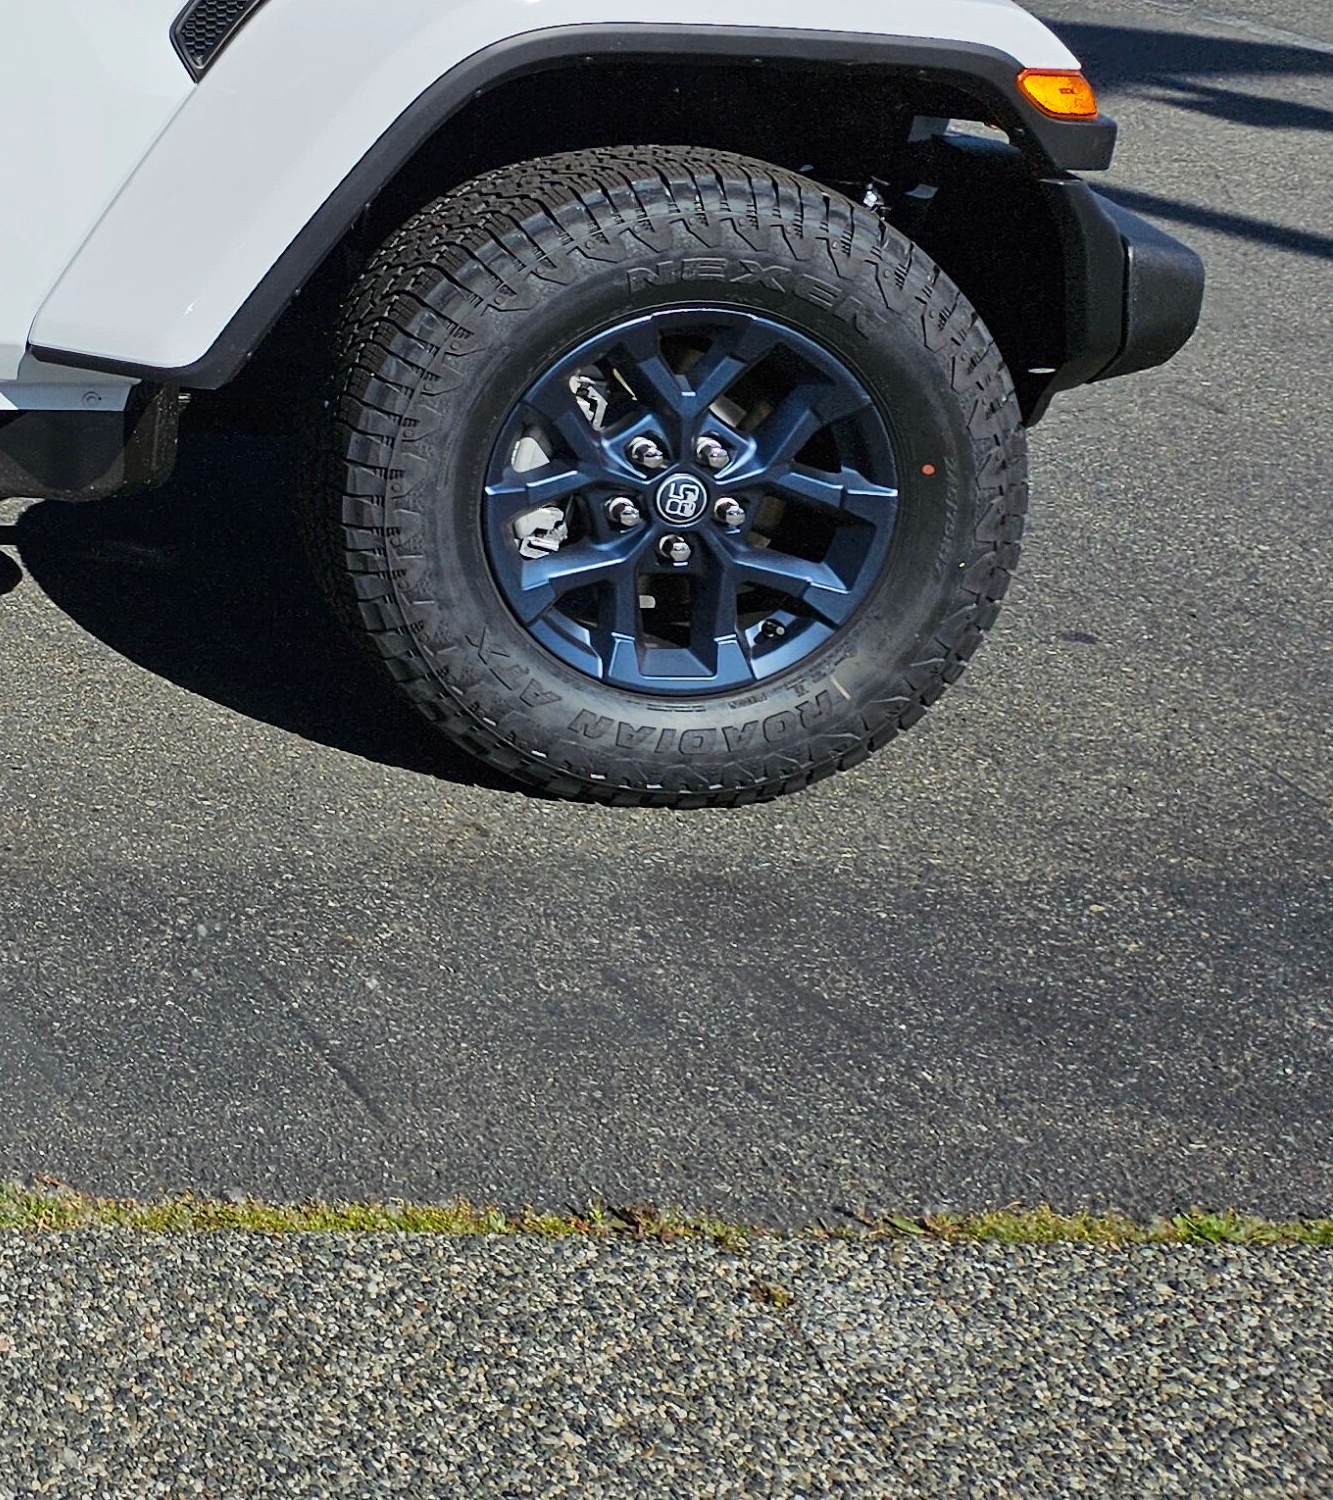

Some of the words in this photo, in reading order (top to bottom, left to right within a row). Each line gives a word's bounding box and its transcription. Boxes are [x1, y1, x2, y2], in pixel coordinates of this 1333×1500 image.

[627, 257, 886, 340] NEXEN
[665, 482, 700, 518] 85
[567, 690, 832, 755] ROADIAN
